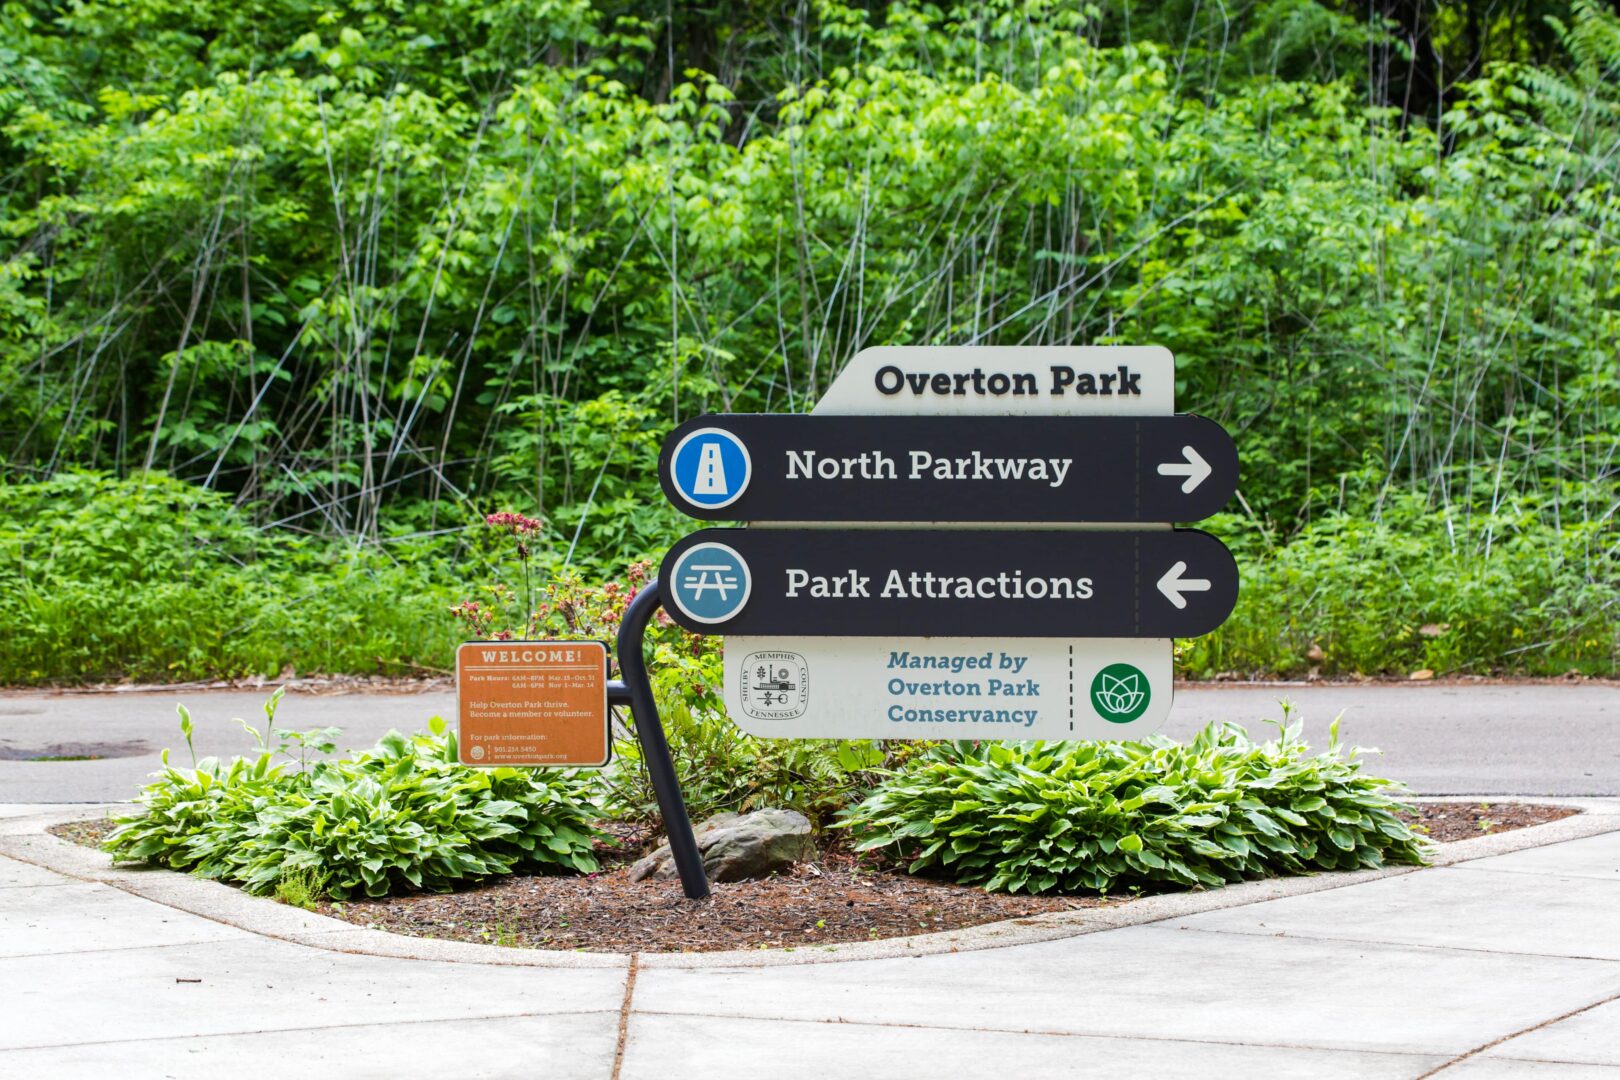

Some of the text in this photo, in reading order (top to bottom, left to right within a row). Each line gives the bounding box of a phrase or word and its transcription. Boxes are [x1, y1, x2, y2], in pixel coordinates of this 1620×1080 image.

[874, 364, 1141, 396] Overton Park
[785, 450, 1072, 488] North Parkway
[785, 568, 1094, 599] Park Attractions
[481, 650, 582, 663] WELCOME!
[754, 653, 796, 661] MEMPHIS
[887, 652, 1028, 676] Managed by
[887, 678, 1040, 697] Overton Park
[469, 701, 569, 709] Help Overton Park thrive.
[470, 710, 502, 718] Become
[508, 710, 541, 718] member
[553, 710, 594, 718] volunteer.
[750, 708, 801, 718] TENNESSEE
[887, 704, 1038, 727] Conservancy
[483, 734, 500, 742] park
[494, 753, 567, 761] www.overtonpark.org
